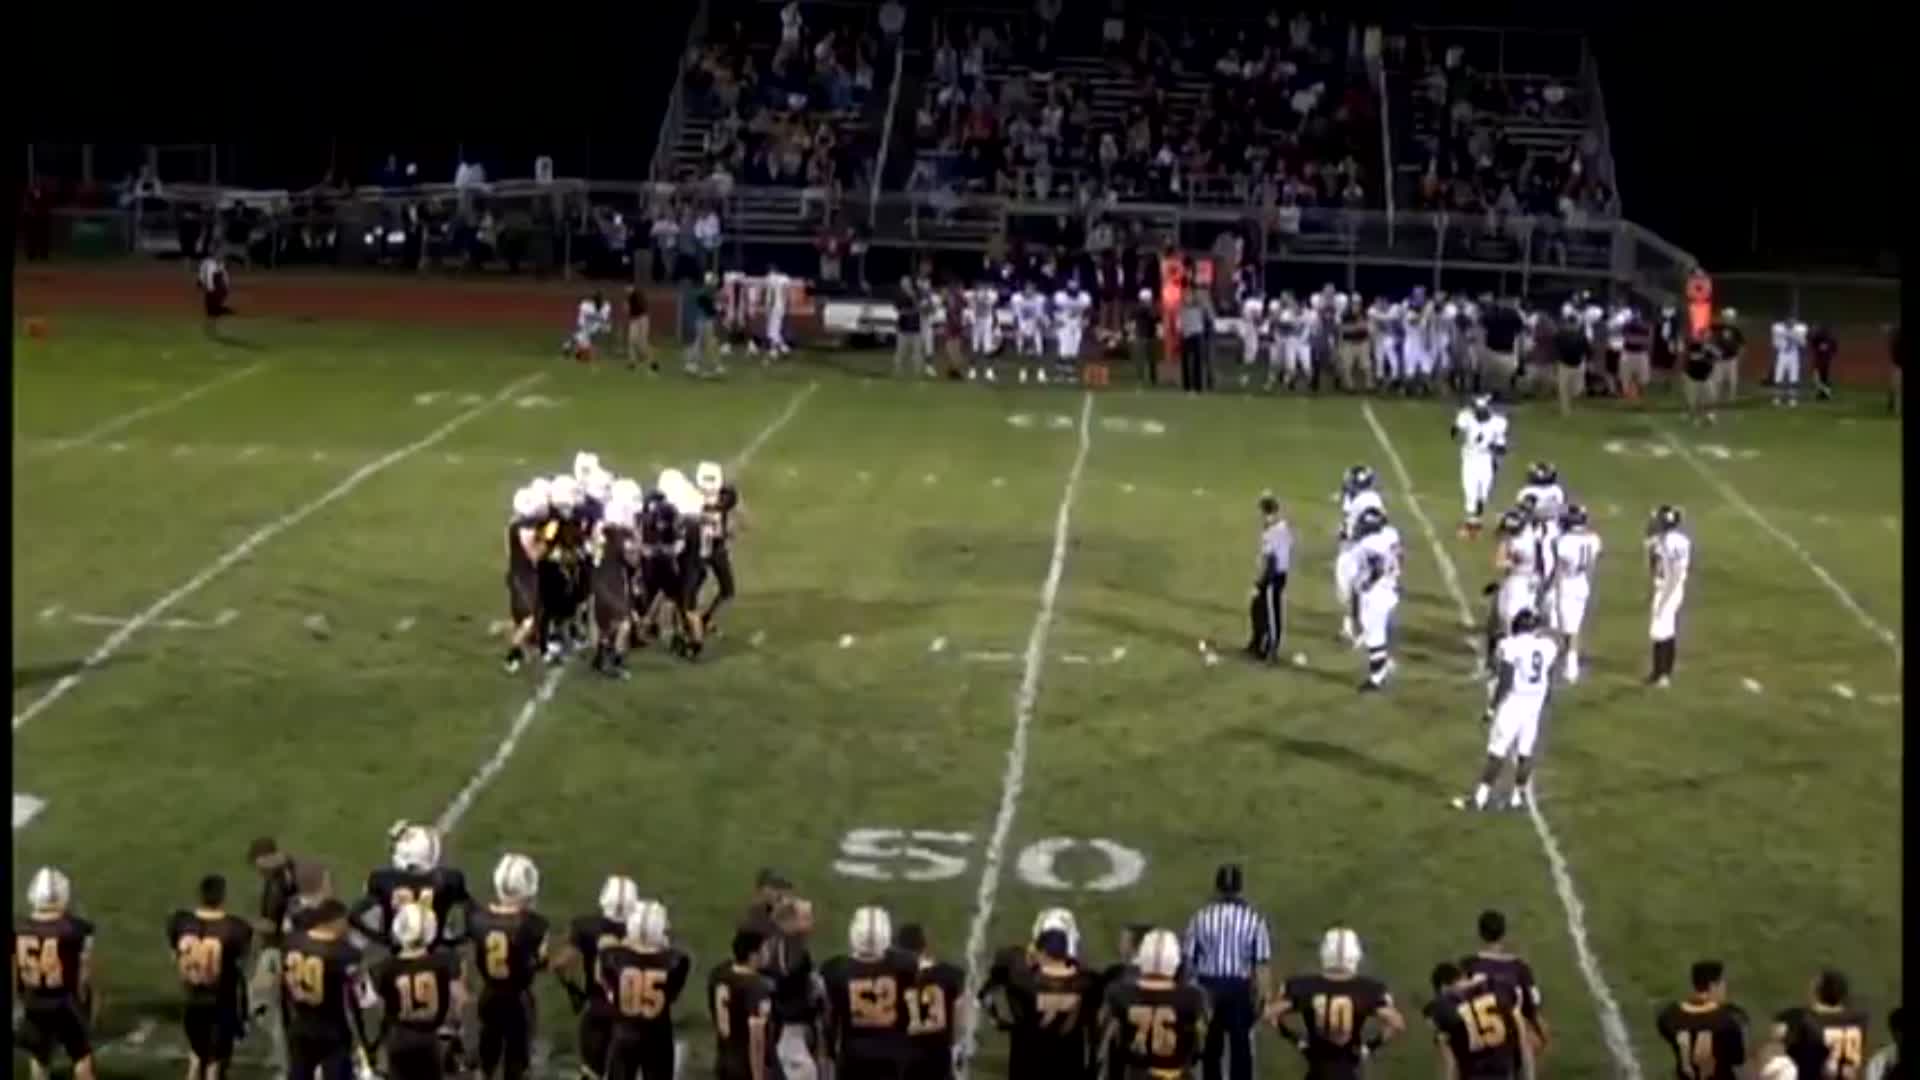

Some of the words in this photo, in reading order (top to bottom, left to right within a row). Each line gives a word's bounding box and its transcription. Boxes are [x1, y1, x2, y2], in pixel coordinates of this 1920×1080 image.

[833, 828, 1145, 892] 50
[16, 934, 64, 989] 54
[485, 930, 509, 980] 2
[395, 970, 439, 1023] 19
[850, 976, 898, 1029] 52
[904, 983, 947, 1037] 13
[1311, 993, 1354, 1047] 10
[1456, 993, 1506, 1053] 15
[1128, 1004, 1178, 1058] 76
